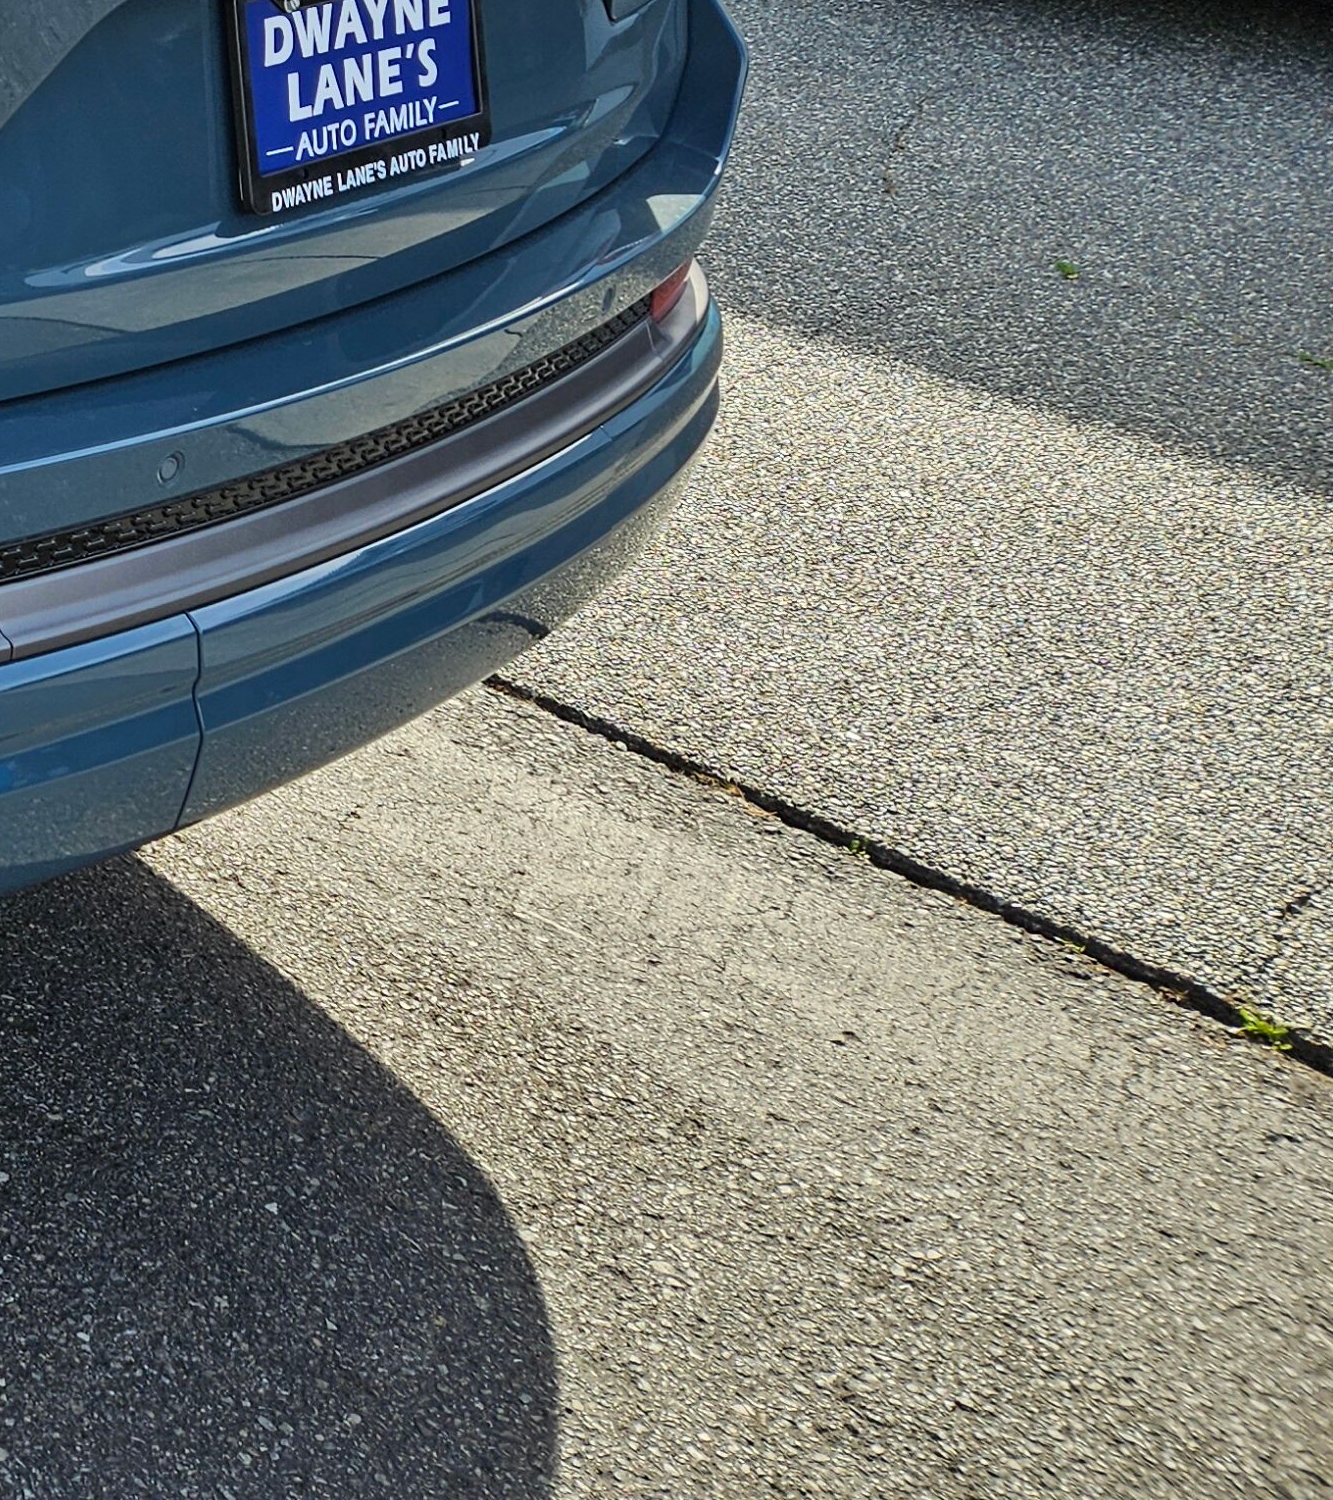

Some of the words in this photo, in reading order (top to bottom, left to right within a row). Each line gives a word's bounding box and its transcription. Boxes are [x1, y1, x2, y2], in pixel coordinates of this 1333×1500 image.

[287, 37, 438, 123] LANE'S
[295, 120, 357, 161] AUTO
[364, 96, 438, 141] FAMILY
[271, 176, 334, 213] DWAYNE
[337, 160, 387, 192] LANE'S
[390, 148, 426, 176] AUTO
[429, 132, 480, 164] FAMILY
